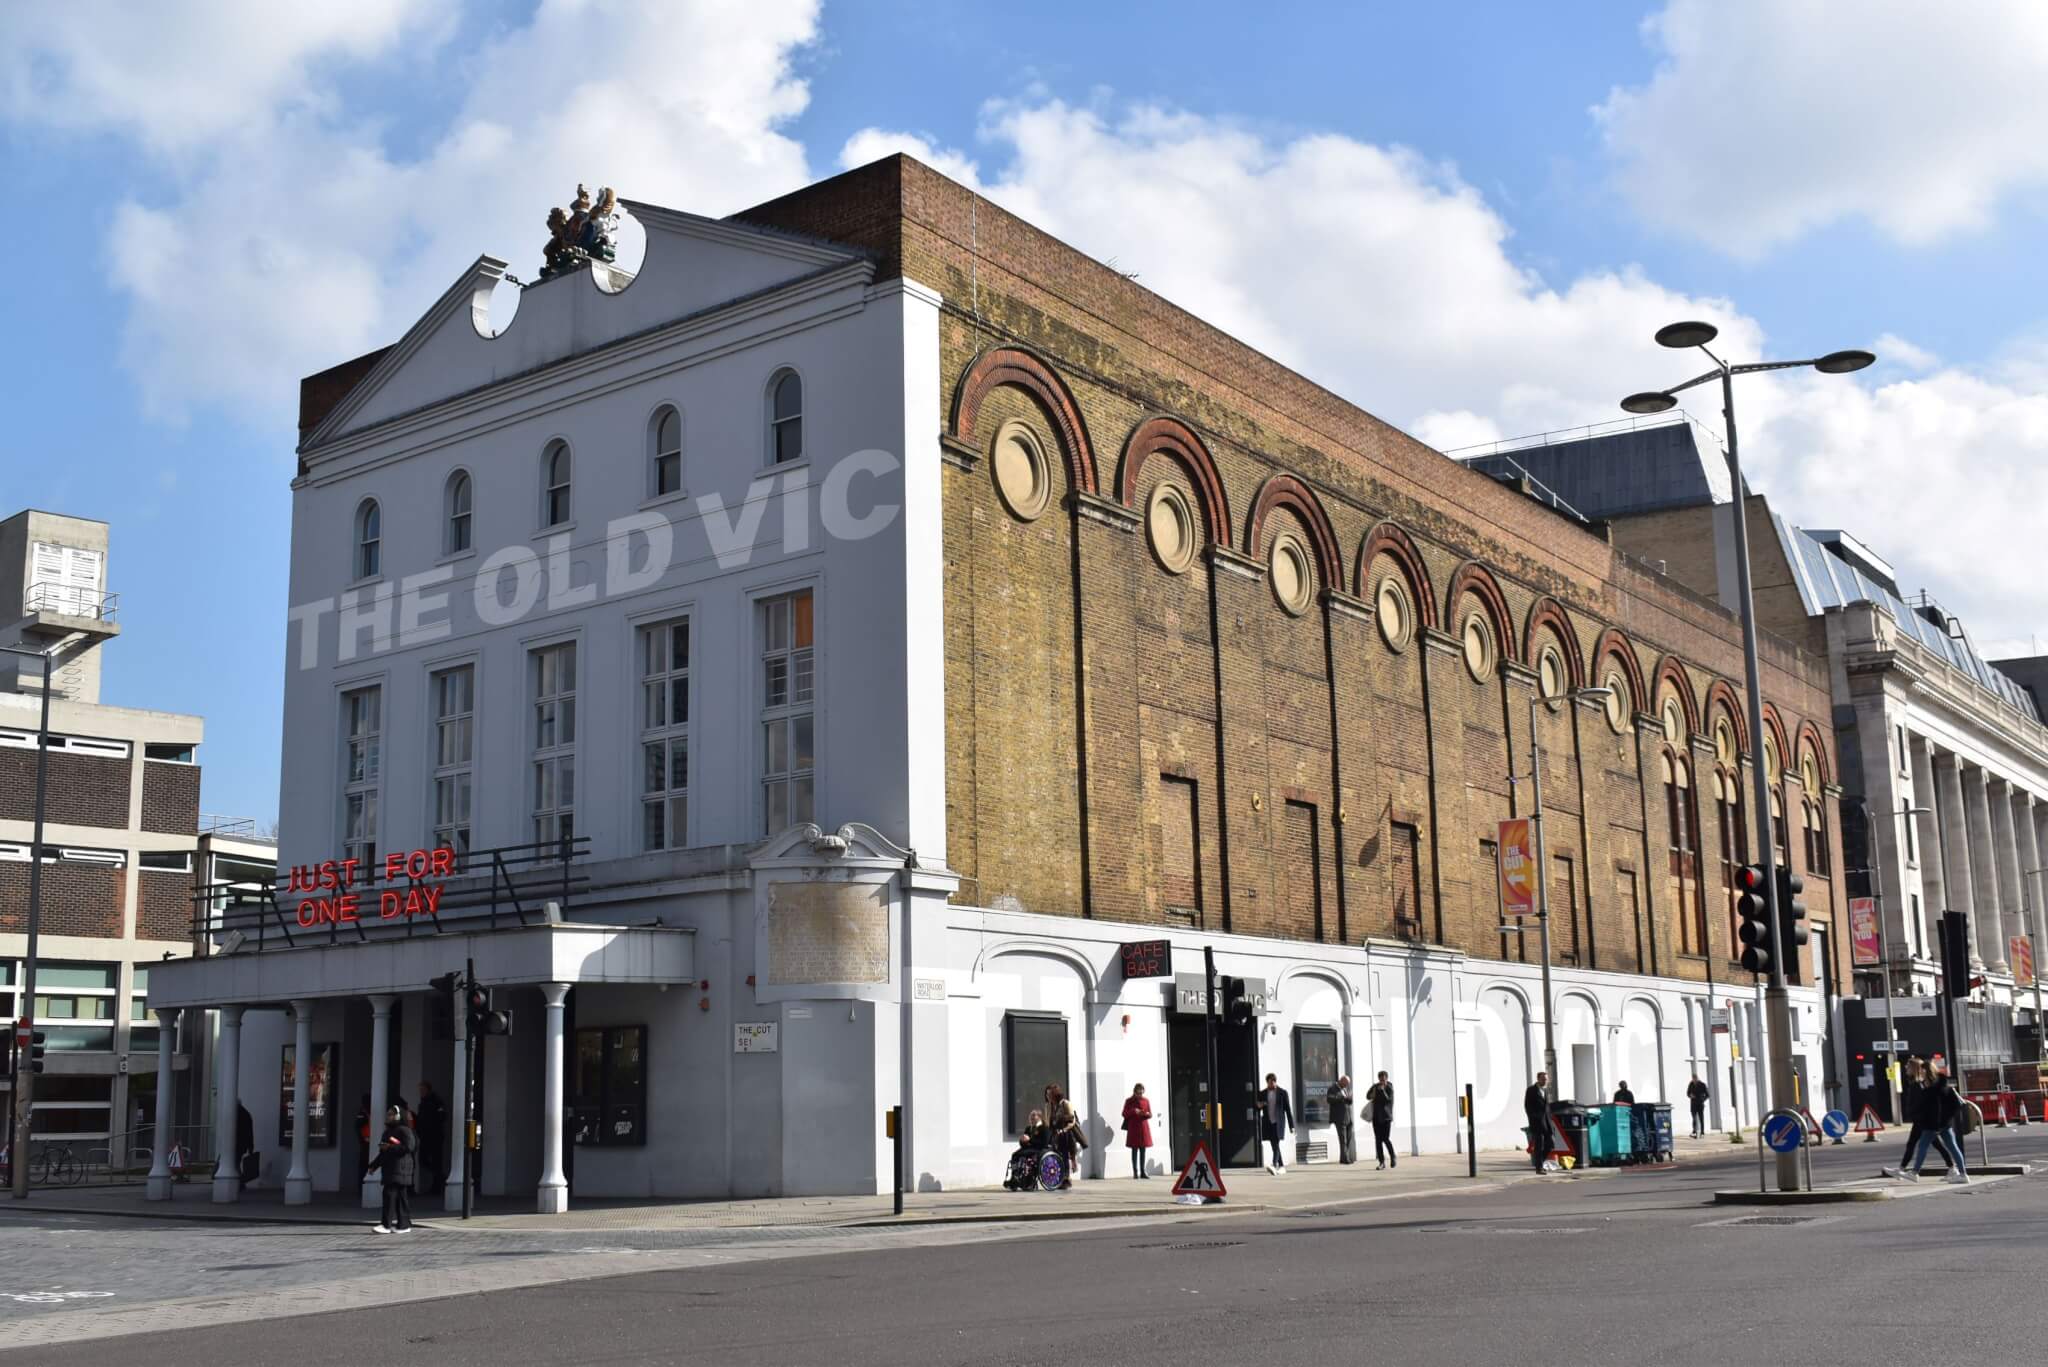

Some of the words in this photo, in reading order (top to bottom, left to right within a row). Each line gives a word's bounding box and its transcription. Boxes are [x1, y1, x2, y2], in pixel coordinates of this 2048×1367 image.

[289, 564, 453, 671] THE
[472, 511, 674, 626] OLD
[696, 448, 901, 570] VIC
[1503, 854, 1525, 870] CUT
[288, 858, 360, 893] JUST
[385, 848, 456, 882] FOR
[296, 892, 361, 927] ONE
[379, 884, 444, 921] DAY
[1121, 941, 1163, 959] CAFE
[1127, 960, 1160, 976] BAR
[1179, 990, 1207, 1006] THE
[738, 1026, 753, 1034] THE
[756, 1025, 772, 1034] CUT
[738, 1038, 752, 1047] SE1
